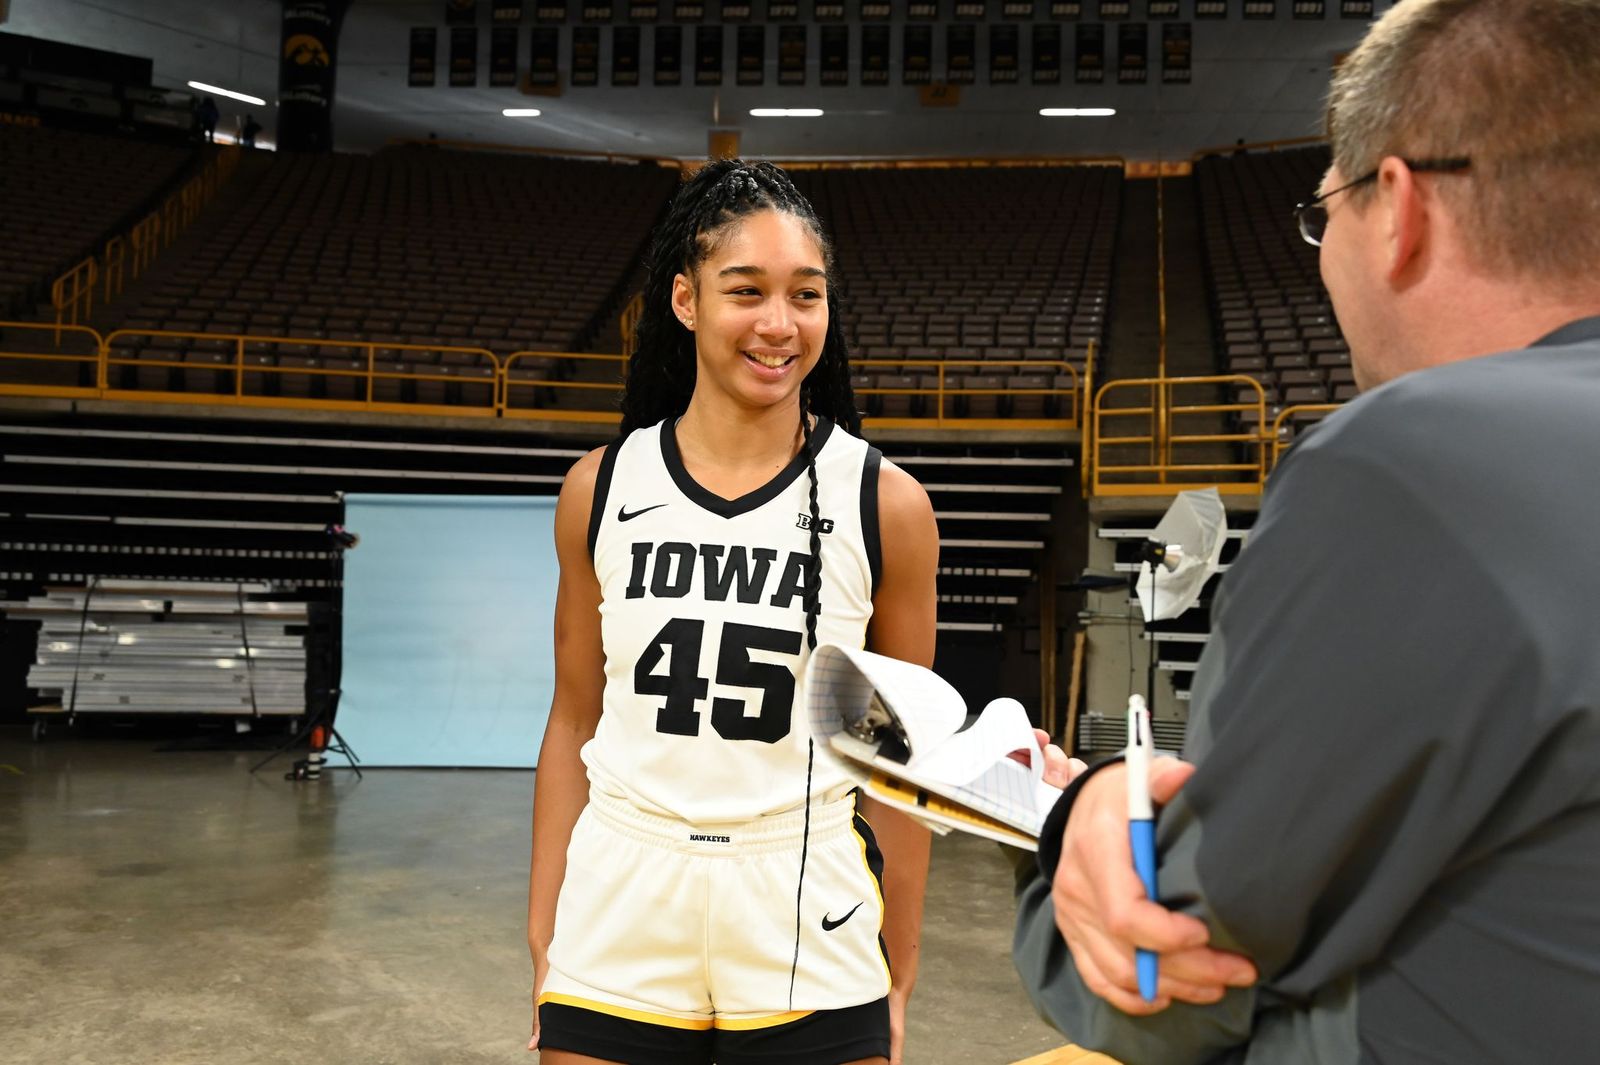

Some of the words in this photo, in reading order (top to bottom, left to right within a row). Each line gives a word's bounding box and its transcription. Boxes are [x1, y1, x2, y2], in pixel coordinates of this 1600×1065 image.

[796, 513, 834, 534] BG
[625, 541, 822, 616] IOWA
[634, 617, 803, 744] 45
[689, 834, 731, 843] HAWKEYES
